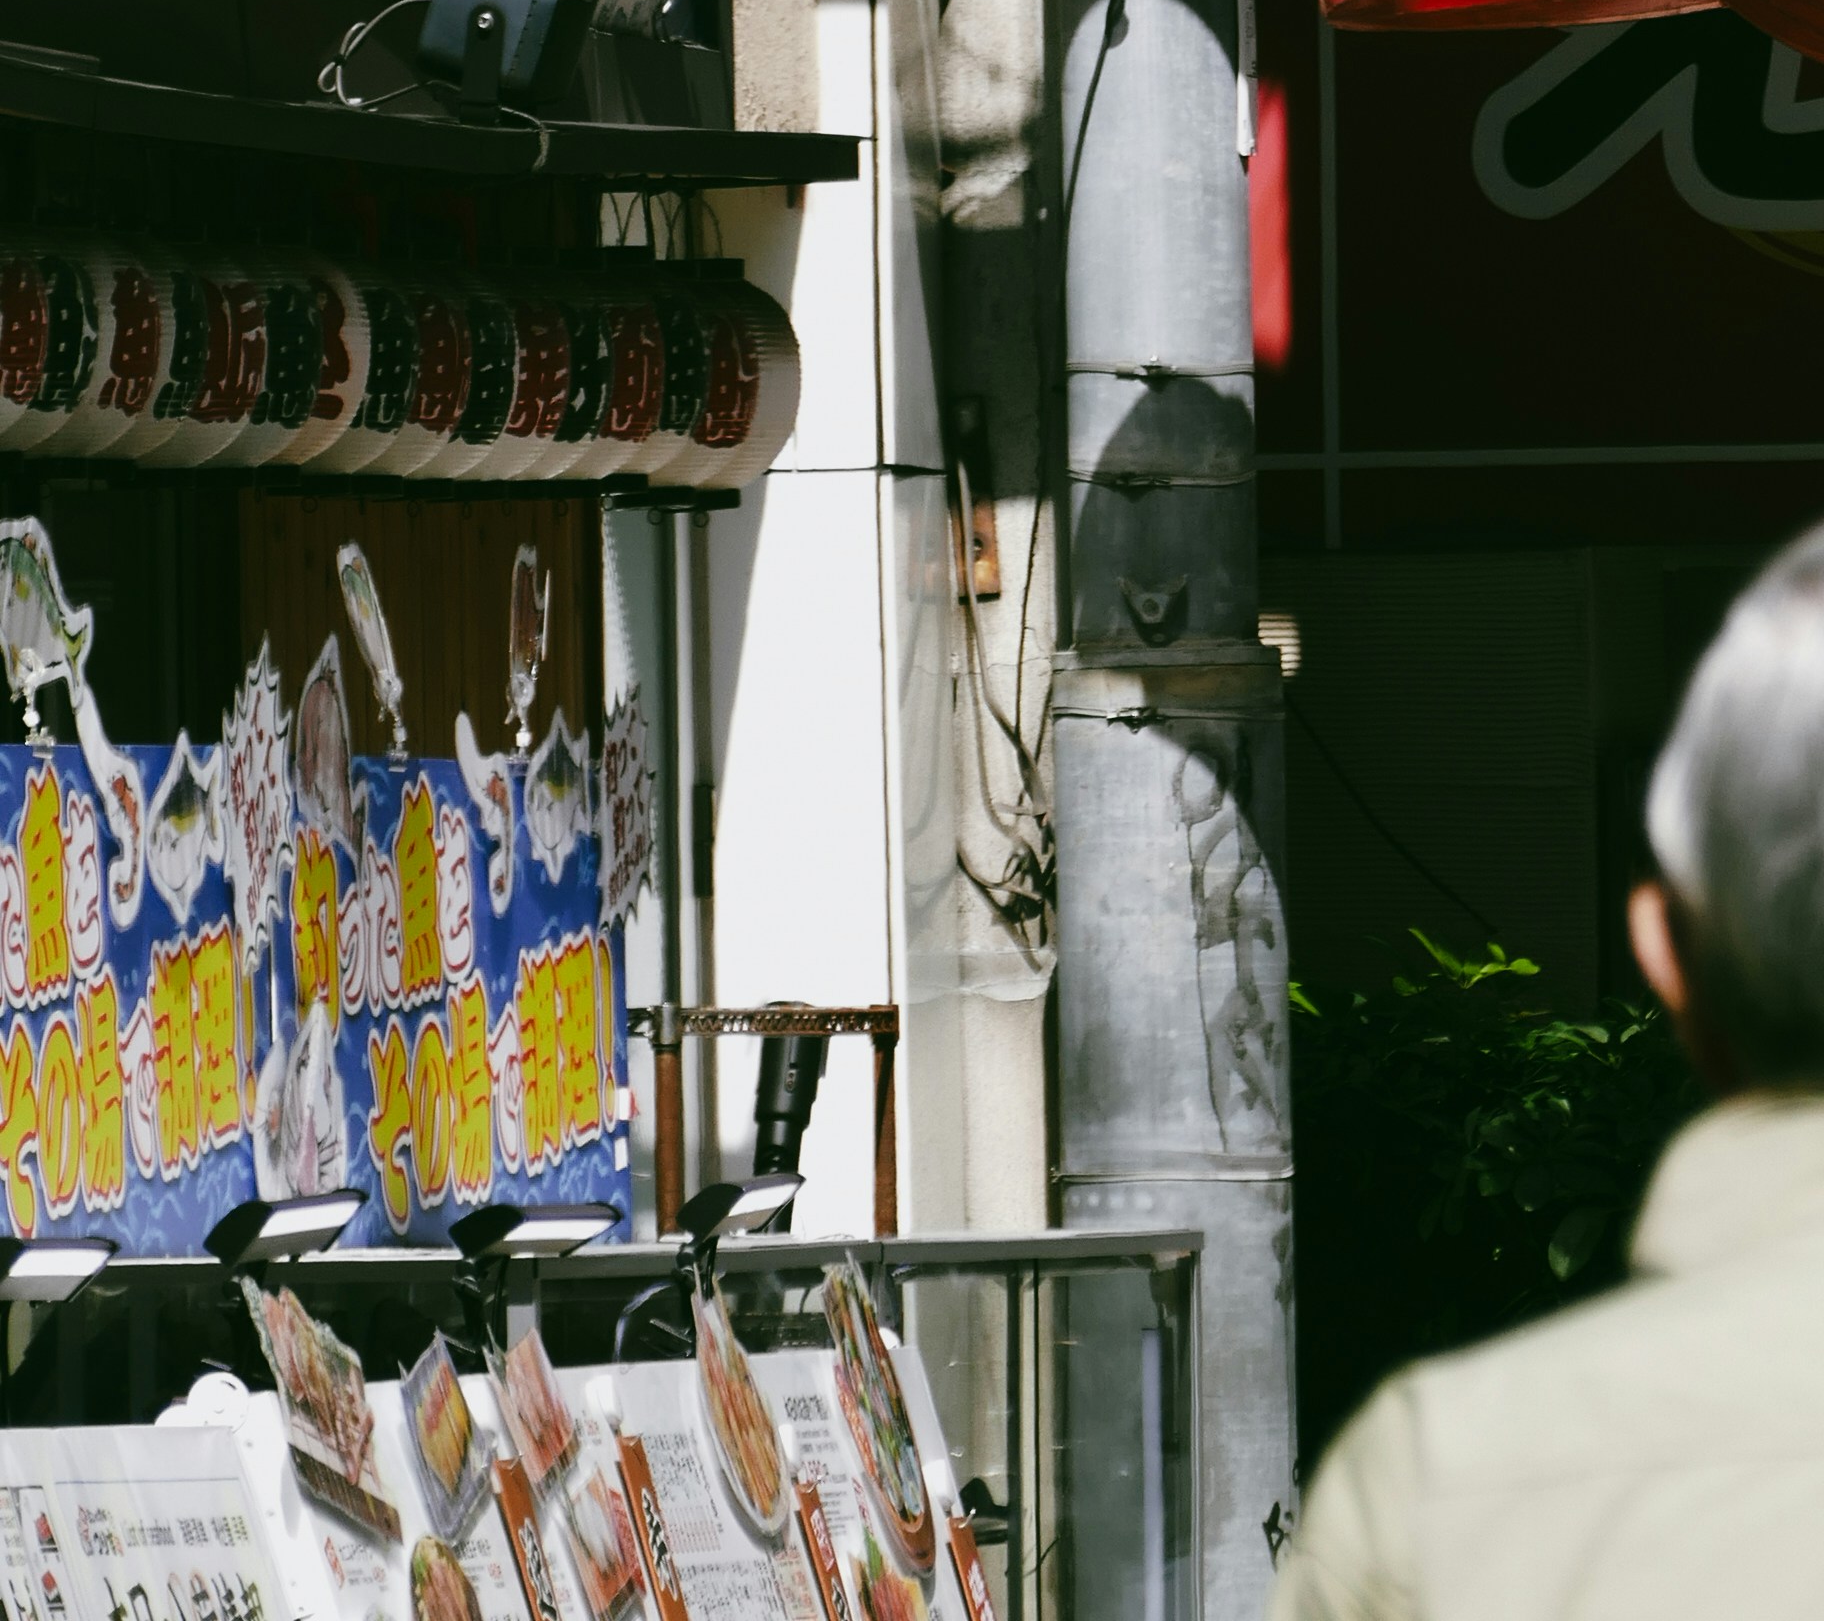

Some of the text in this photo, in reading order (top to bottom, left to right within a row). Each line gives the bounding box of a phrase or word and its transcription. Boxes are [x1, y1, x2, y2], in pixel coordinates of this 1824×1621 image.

[369, 926, 616, 1234] その場で調理!
